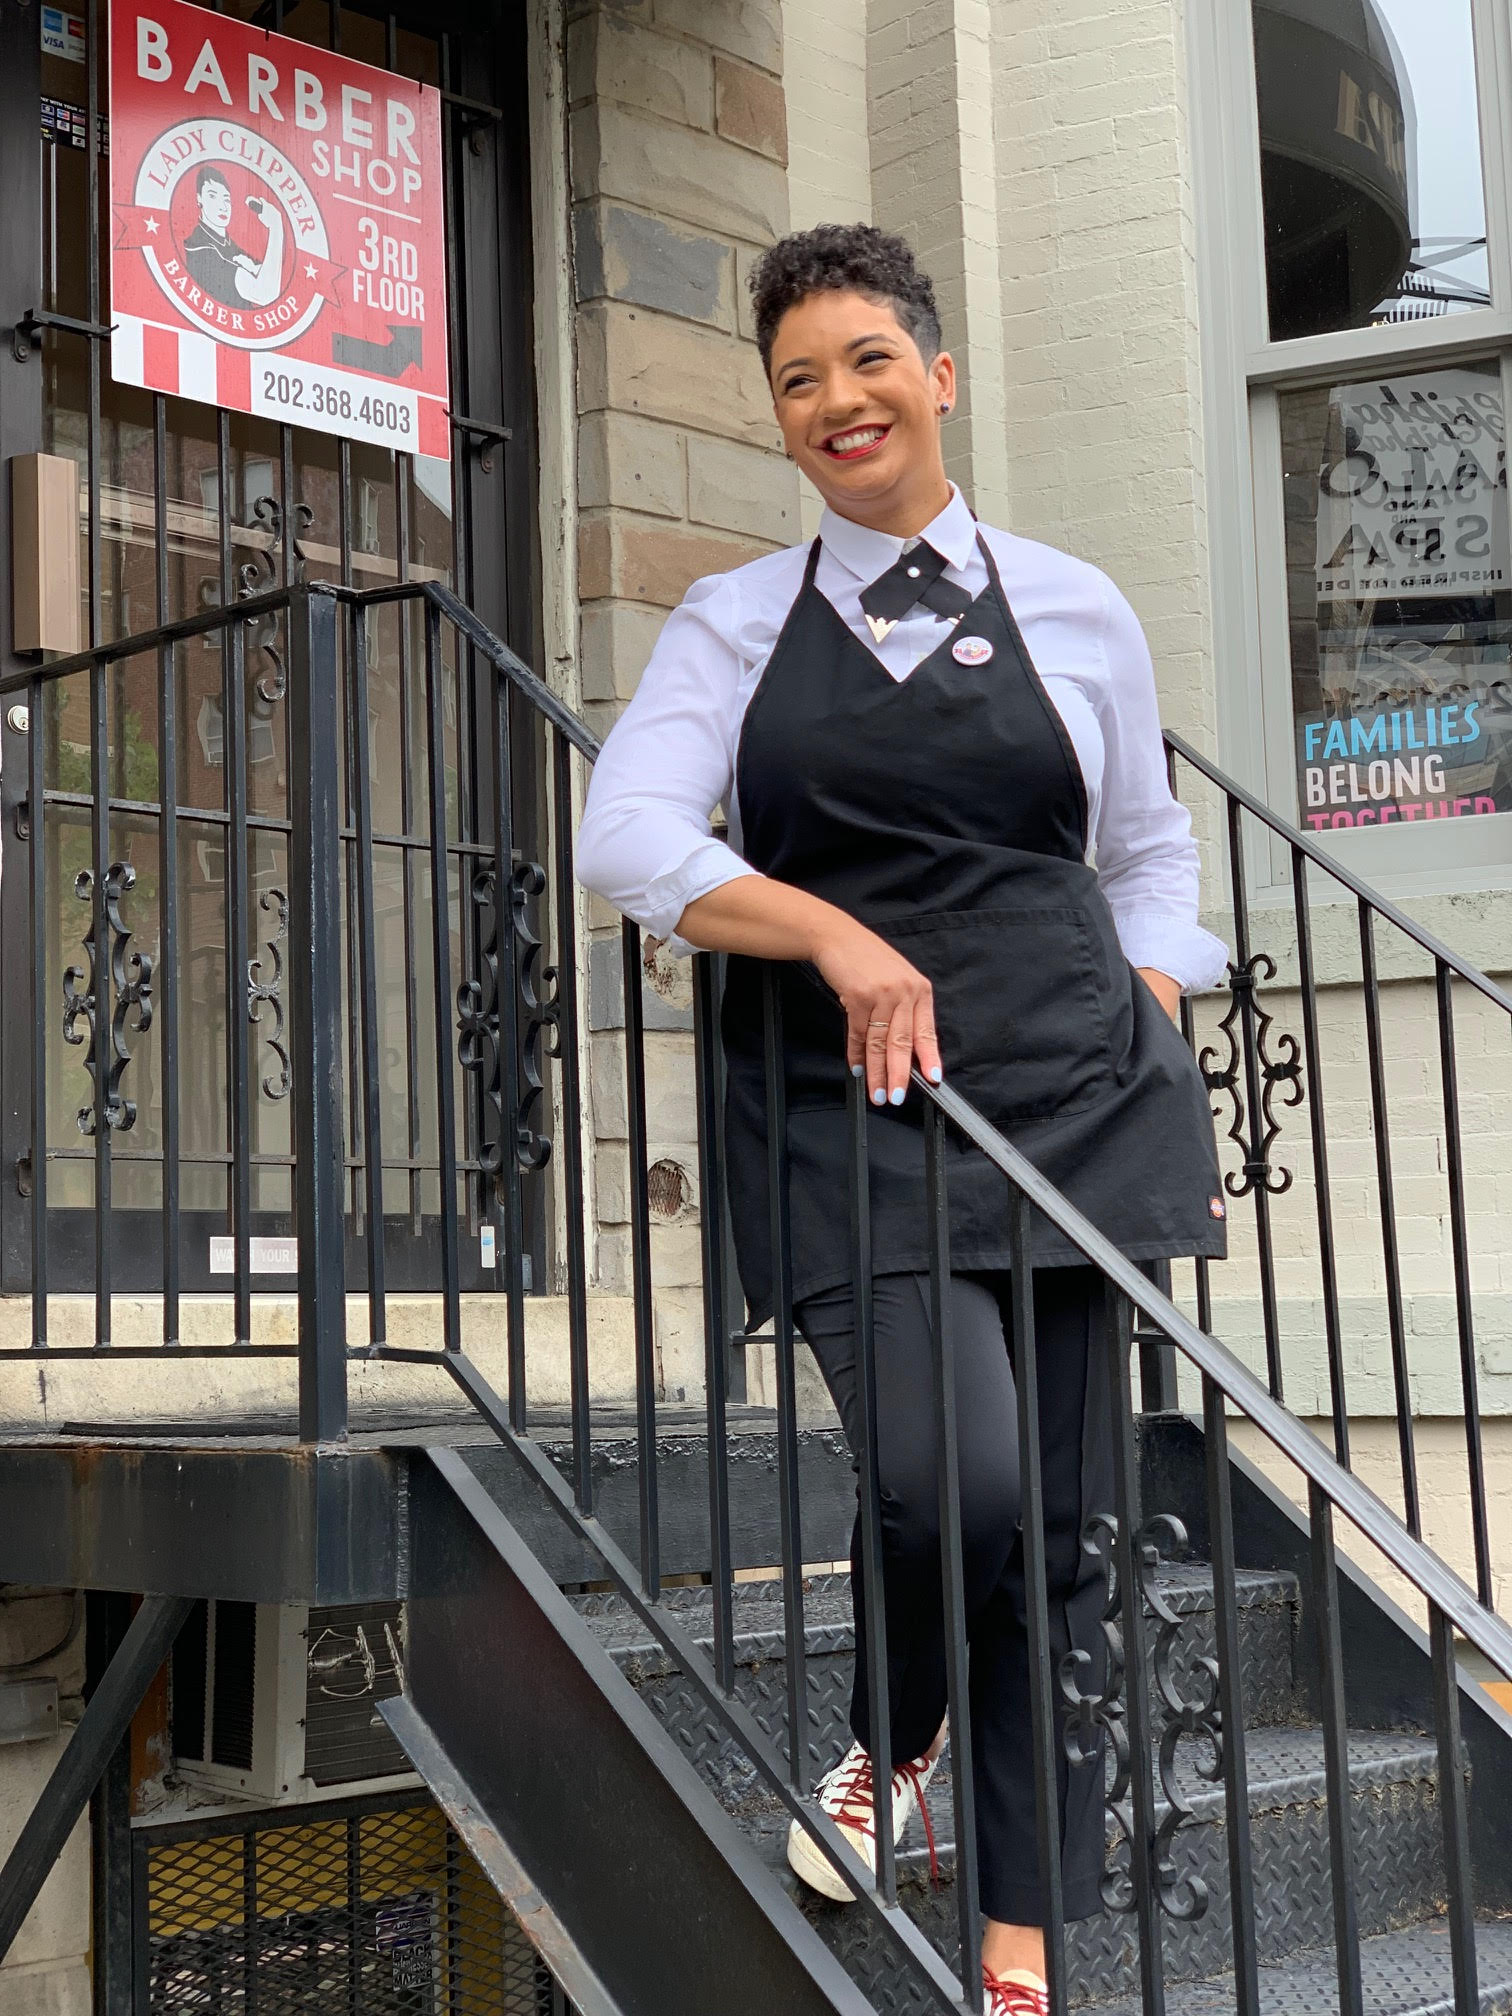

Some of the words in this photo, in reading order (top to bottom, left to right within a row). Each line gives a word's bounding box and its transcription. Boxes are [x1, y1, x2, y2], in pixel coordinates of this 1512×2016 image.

[43, 34, 65, 50] VISA
[136, 15, 422, 166] BARBER
[147, 128, 208, 190] LADY
[218, 129, 316, 236] CLIPPER
[311, 139, 422, 204] SHOP
[357, 216, 418, 283] 3RD
[163, 258, 246, 331] BARBER
[253, 295, 300, 332] SHOP
[352, 268, 426, 322] FLOOR
[263, 370, 412, 435] 202.368.4603
[1305, 701, 1480, 761] FAMILIES
[1306, 754, 1446, 807] BELONG
[261, 1248, 290, 1263] YOUR
